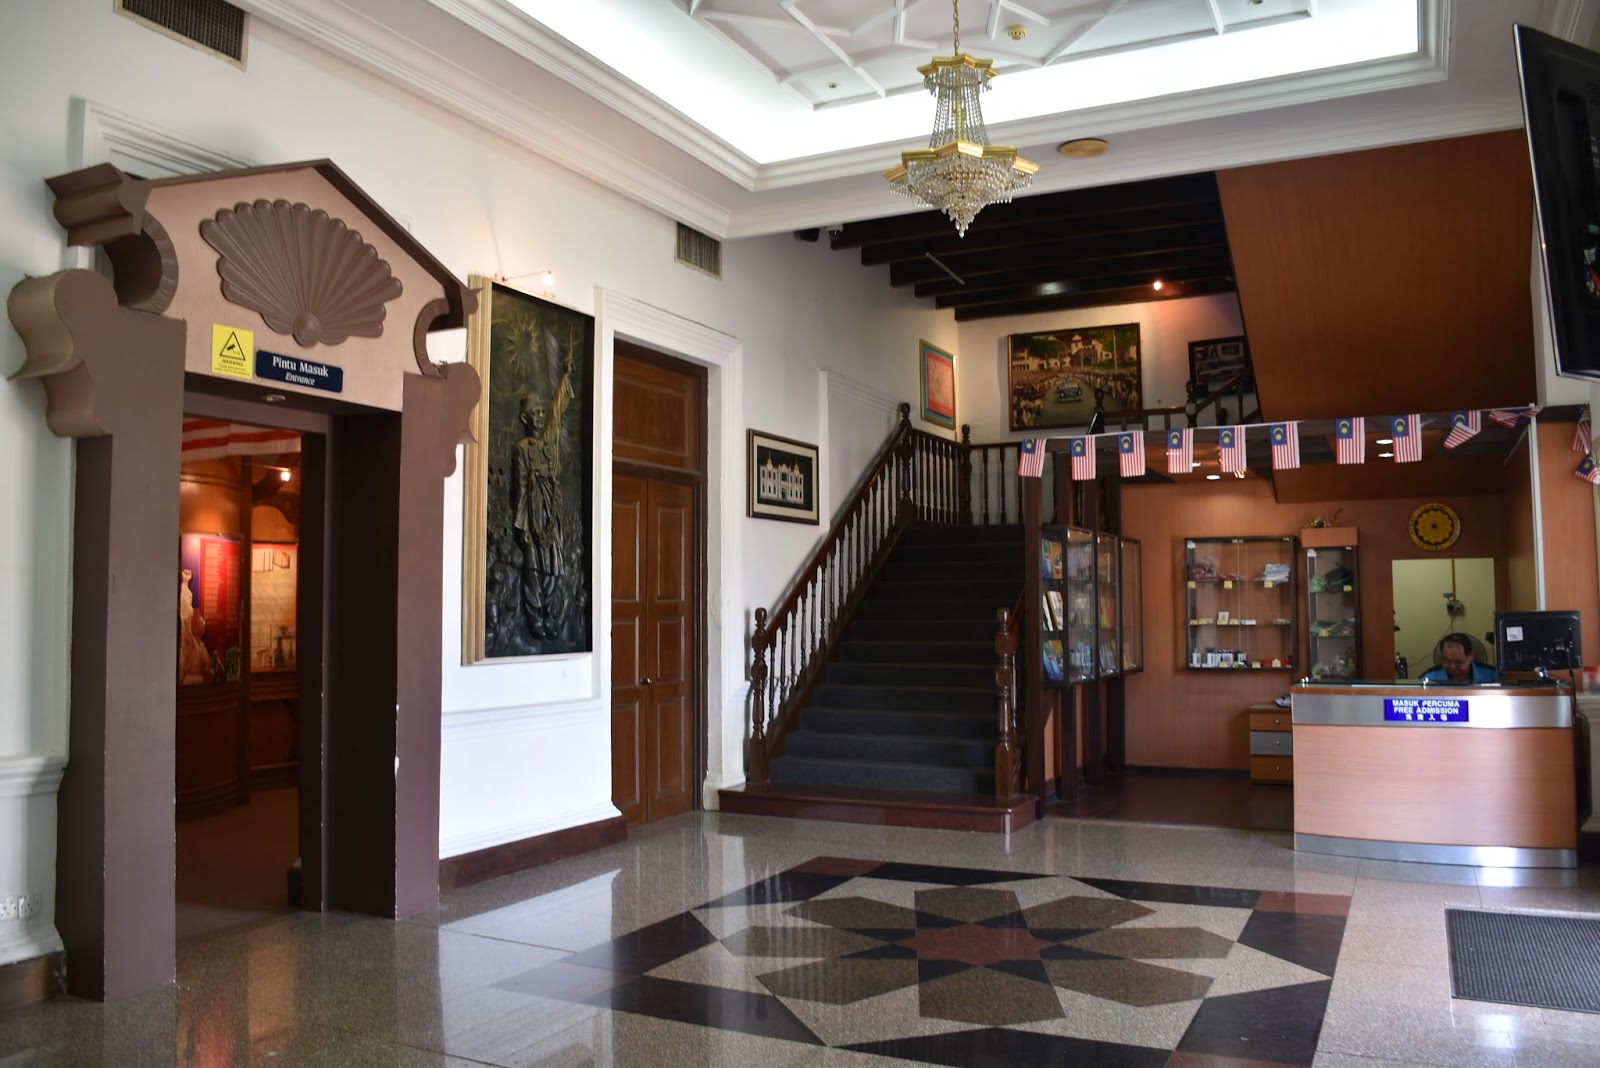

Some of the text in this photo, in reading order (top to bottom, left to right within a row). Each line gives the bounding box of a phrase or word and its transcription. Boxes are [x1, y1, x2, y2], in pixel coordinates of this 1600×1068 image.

[272, 355, 329, 378] Pintu Masuk
[285, 371, 316, 386] Entrance
